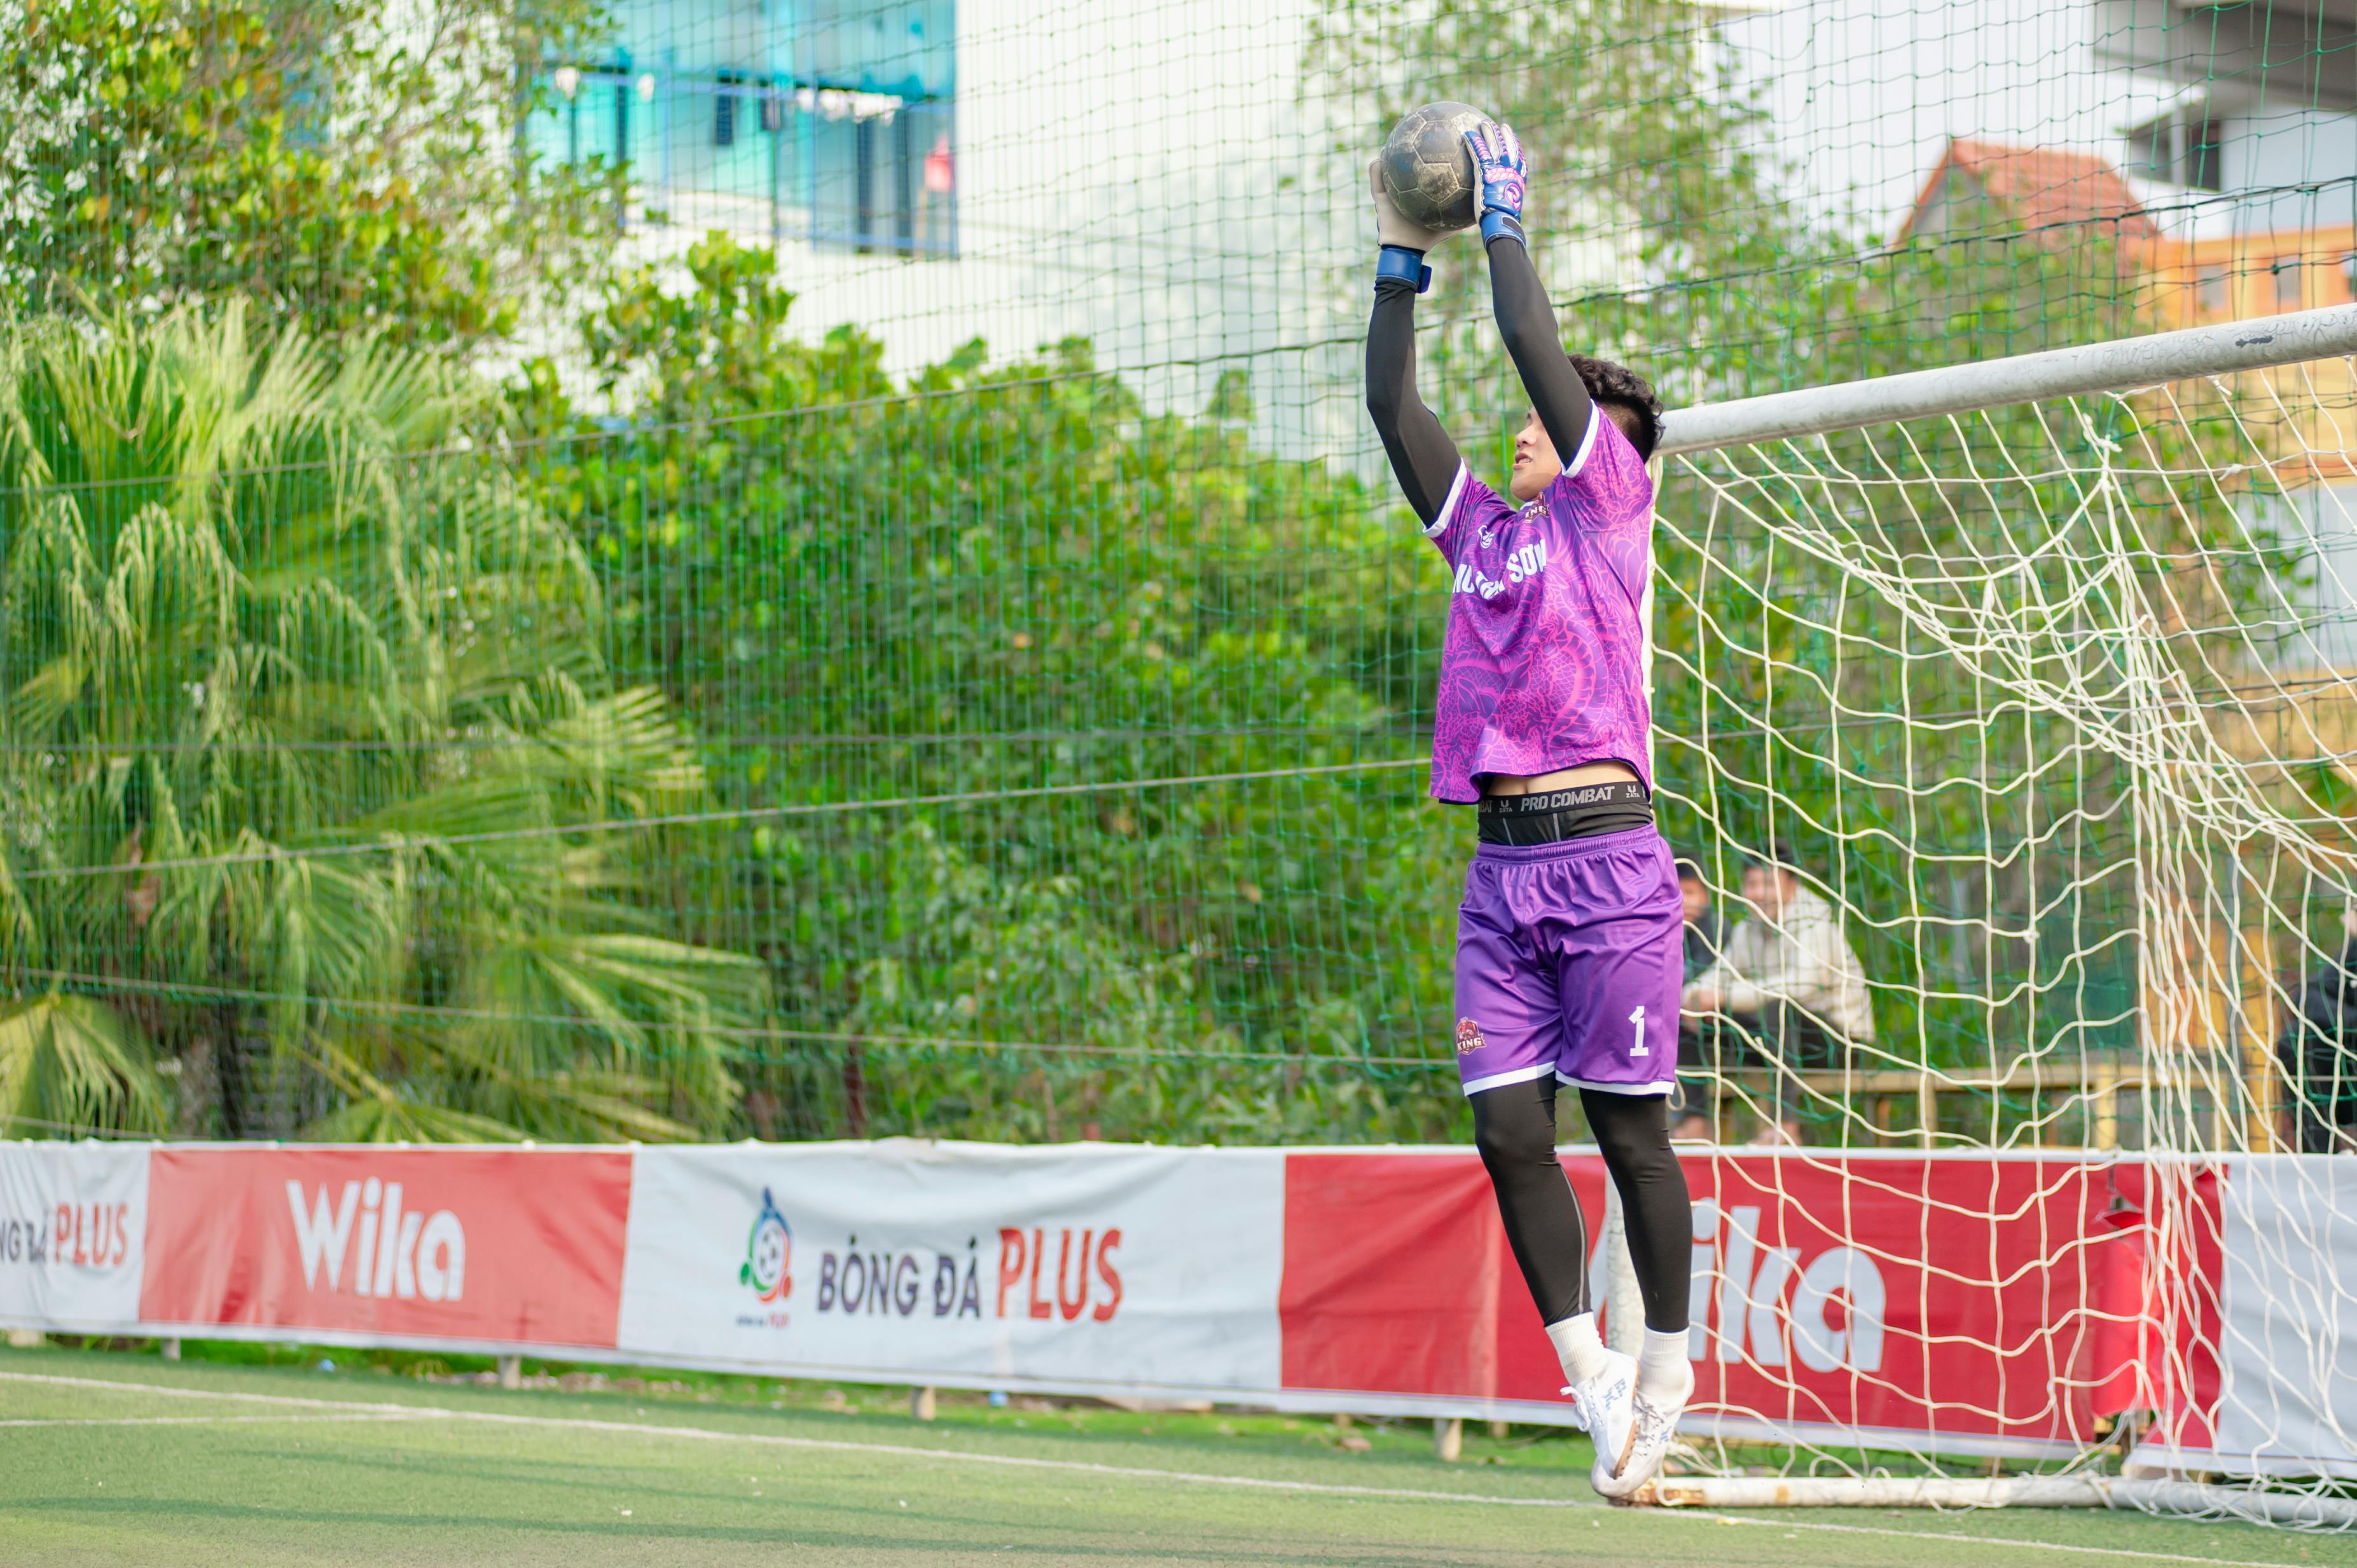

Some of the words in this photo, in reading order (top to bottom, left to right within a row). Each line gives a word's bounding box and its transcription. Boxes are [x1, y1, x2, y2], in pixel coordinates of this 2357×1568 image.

[1521, 795, 1548, 811] PRO
[1551, 786, 1615, 808] COMBAT
[1629, 1005, 1649, 1057] 1
[55, 1202, 130, 1267] PLUS
[286, 1177, 466, 1302] Wika
[997, 1227, 1123, 1323] PLUS
